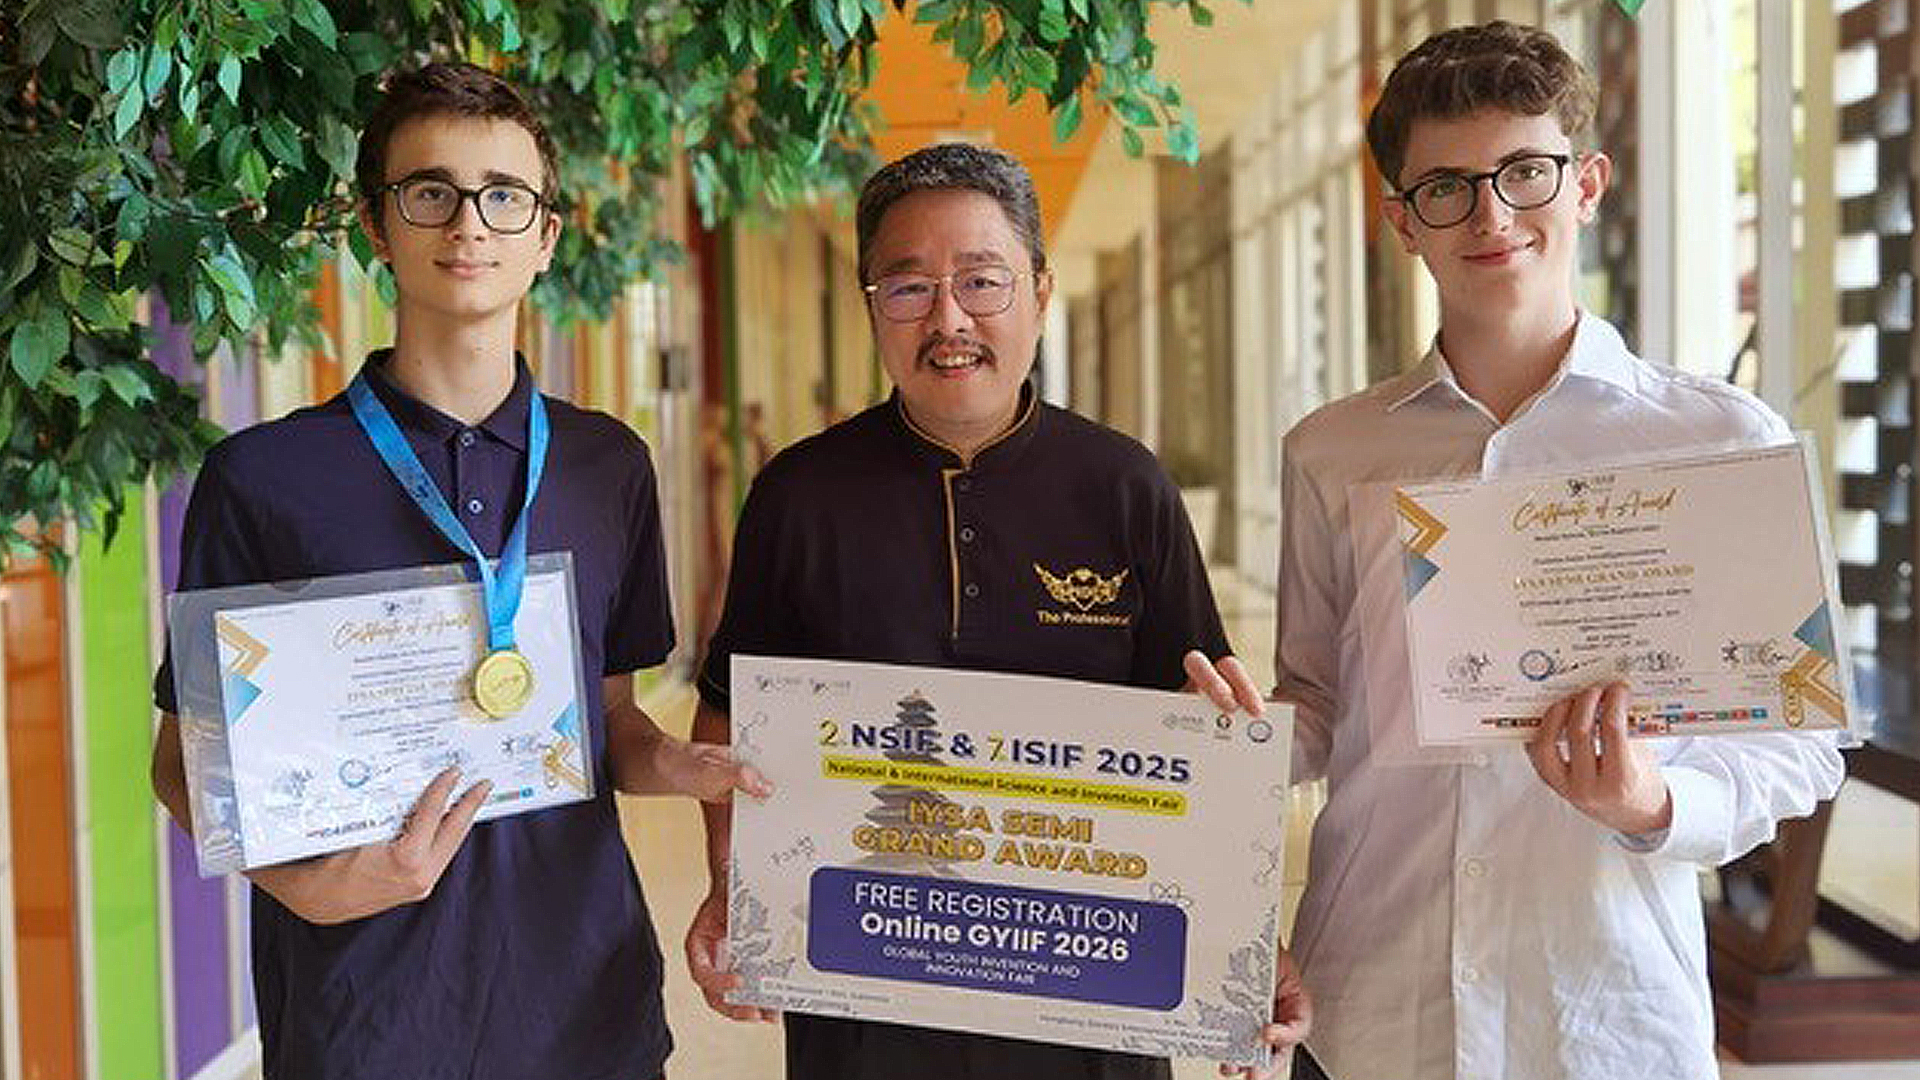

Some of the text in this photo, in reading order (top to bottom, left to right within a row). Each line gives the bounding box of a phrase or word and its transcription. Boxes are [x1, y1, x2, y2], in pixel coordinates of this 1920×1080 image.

[1037, 610, 1061, 624] The
[852, 723, 942, 752] NSIF
[950, 733, 977, 758] &
[1012, 739, 1083, 768] ISIF
[1096, 748, 1190, 783] 2025
[827, 761, 1180, 809] National & International Science and Invention Fair
[909, 799, 1093, 843] IYSA SEMI
[852, 825, 986, 861] GRAND
[995, 839, 1148, 879] AWARD
[855, 882, 1139, 934] FREE REGISTRATION
[861, 911, 1130, 963] Online GYIIF 2026
[882, 944, 1081, 980] GLOBAL YOUTH INVENTION AND
[925, 963, 1036, 985] INNOVATION FAIR
